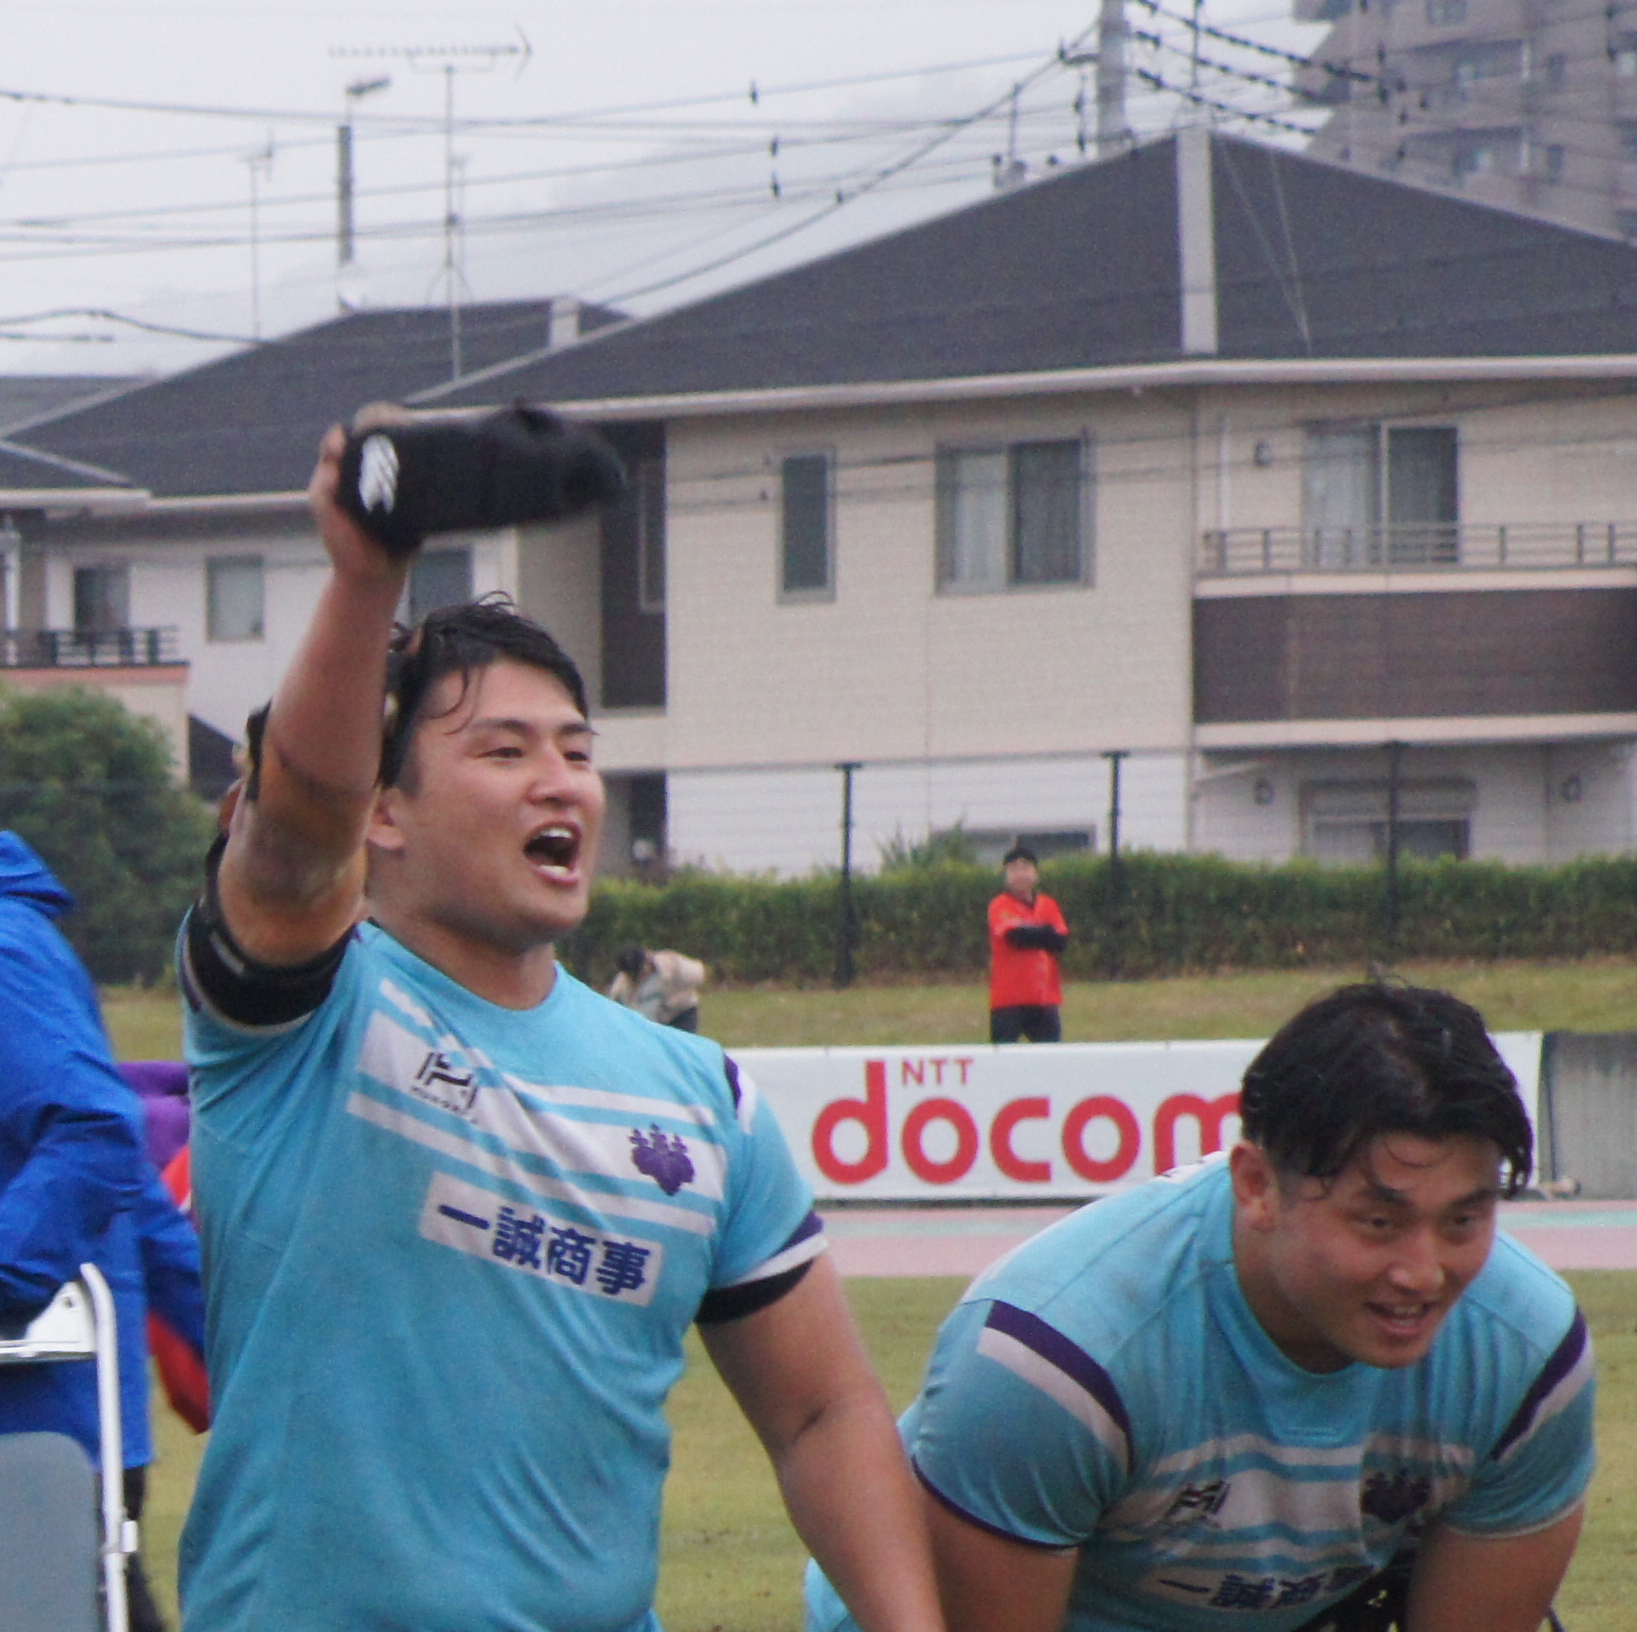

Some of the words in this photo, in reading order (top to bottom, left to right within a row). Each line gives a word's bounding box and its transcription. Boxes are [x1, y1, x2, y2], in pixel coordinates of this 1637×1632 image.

[900, 1057, 975, 1086] NTT
[811, 1059, 1245, 1186] docom
[436, 1203, 651, 1297] 一誠商事
